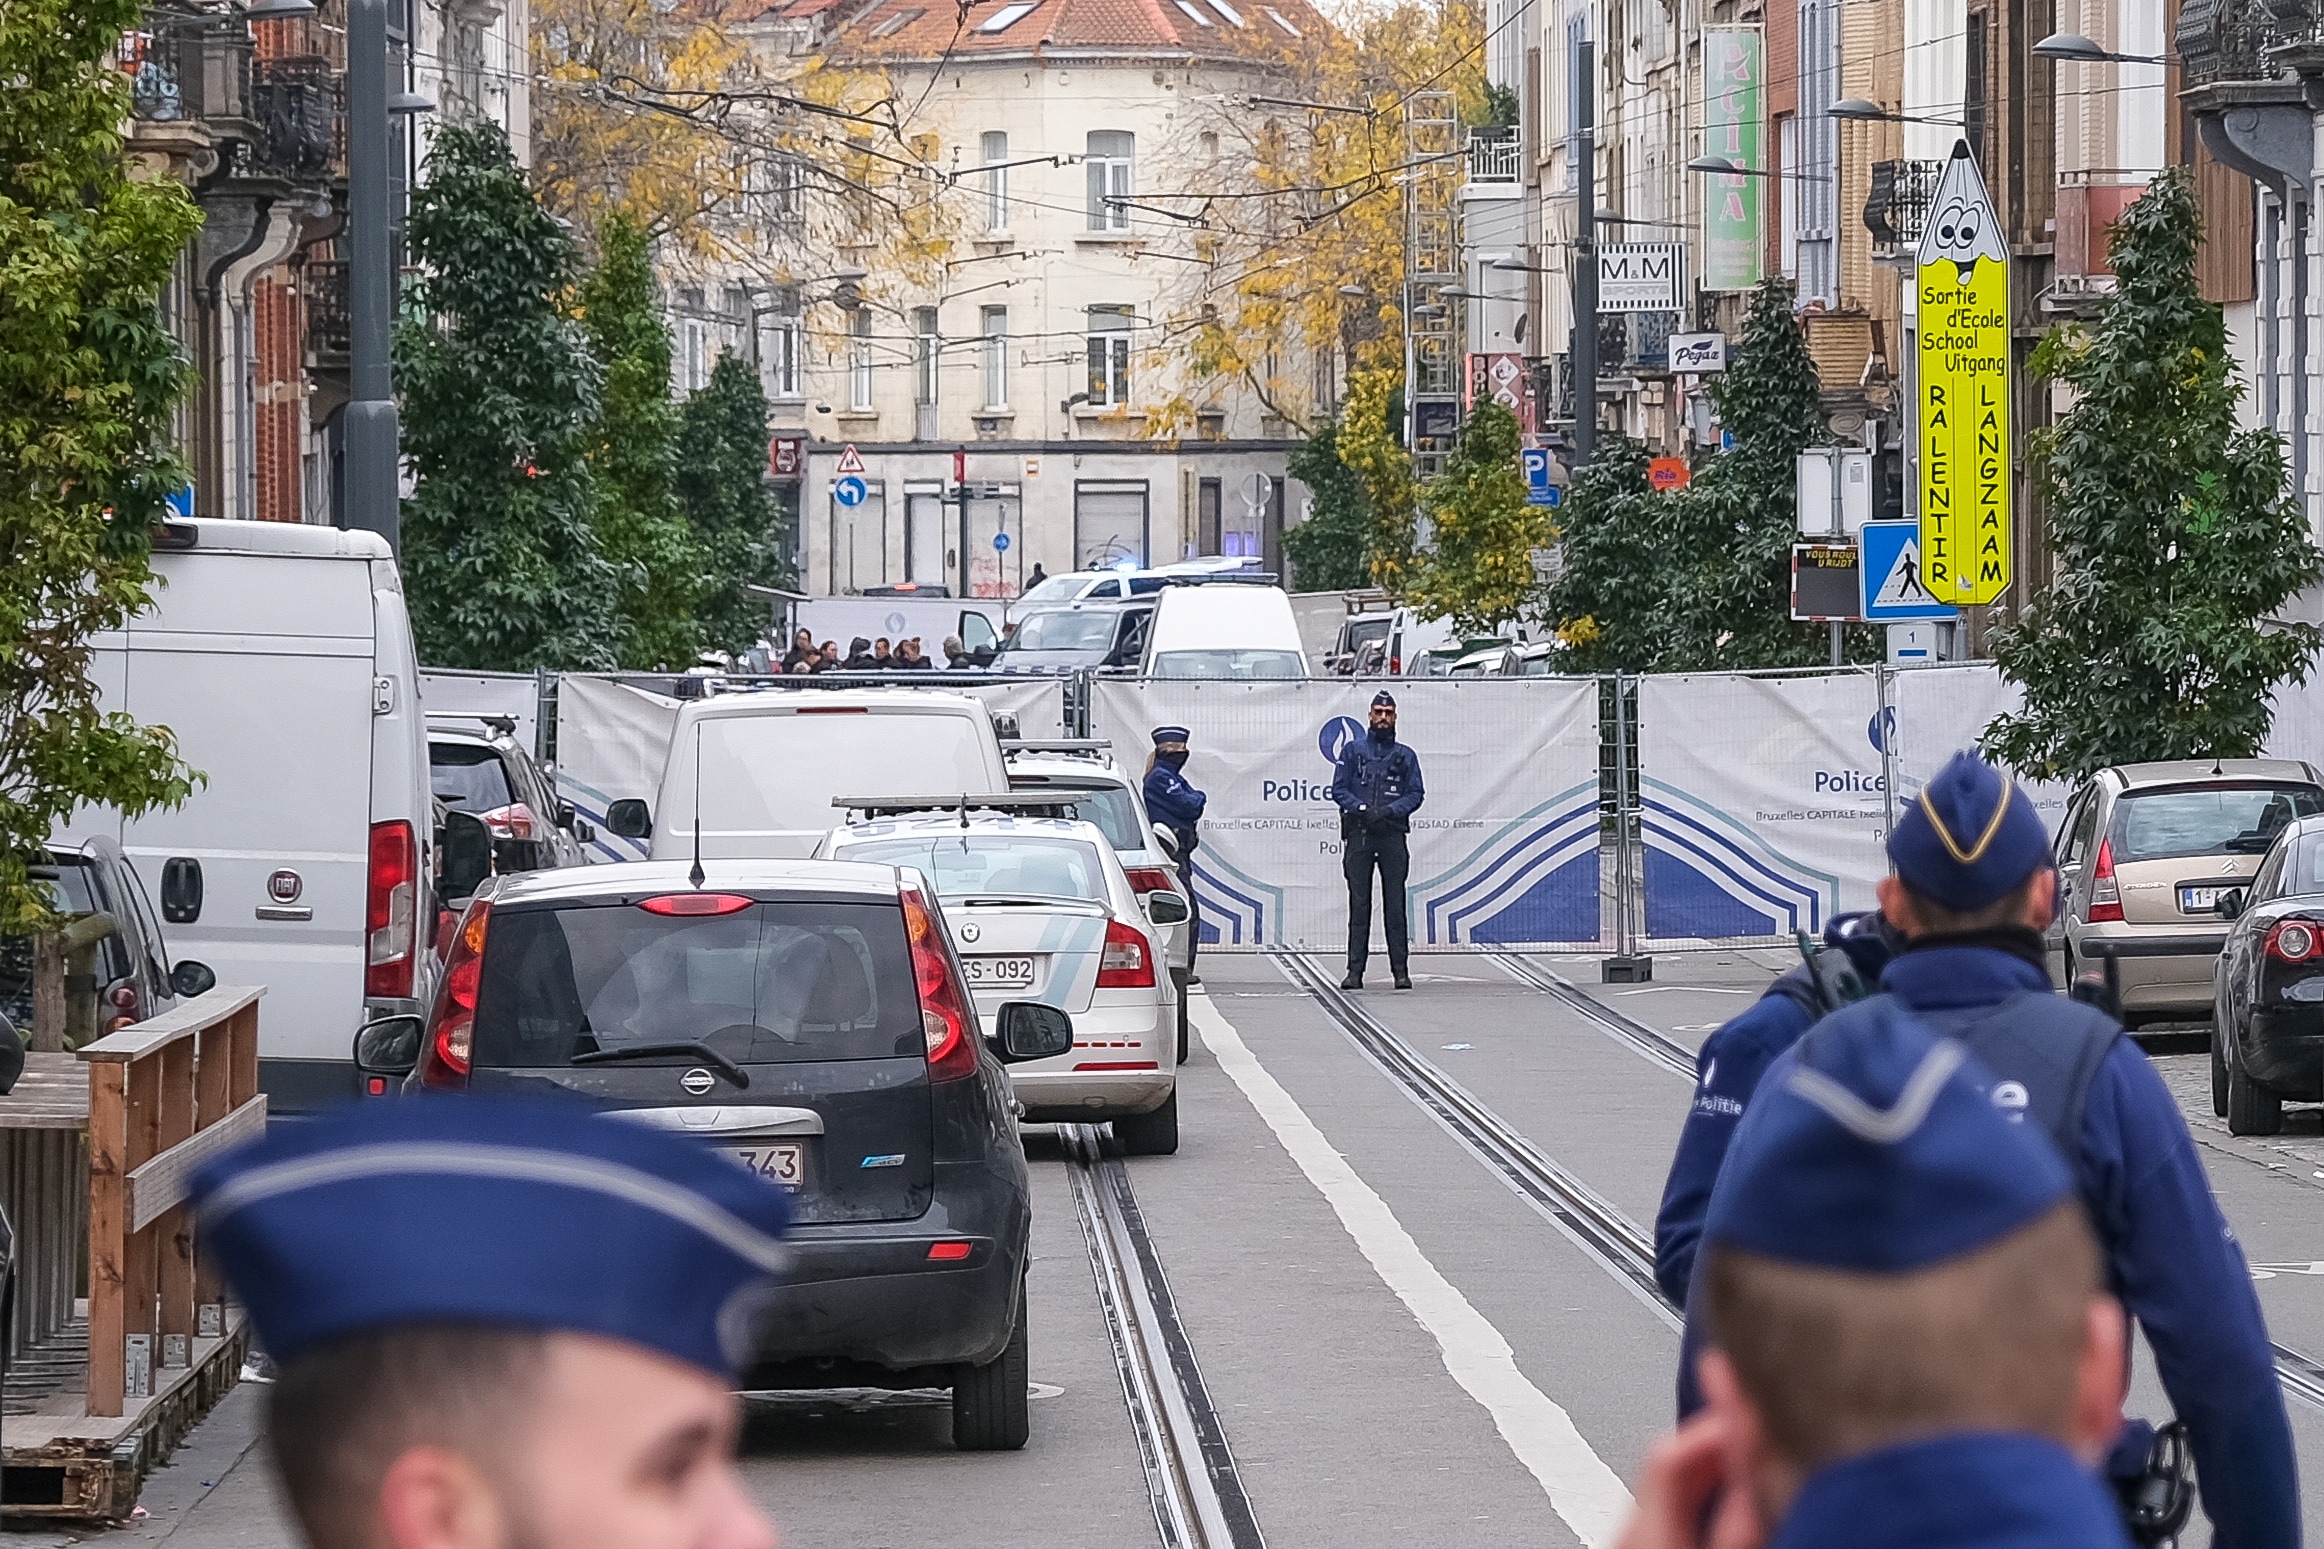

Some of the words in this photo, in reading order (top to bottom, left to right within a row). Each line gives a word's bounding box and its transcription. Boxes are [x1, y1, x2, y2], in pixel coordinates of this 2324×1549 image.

[1923, 286, 1977, 304] Sortie
[1947, 308, 2004, 328] d'Ecole
[1922, 330, 1978, 350] School
[1945, 353, 2005, 377] Uitgang
[1525, 455, 1544, 485] P
[1929, 385, 1949, 583] RALENTIR
[1979, 385, 2003, 582] LANGZAAM
[1806, 551, 1831, 559] VOUS
[1909, 631, 1915, 643] 1
[1263, 780, 1333, 801] Police
[1815, 771, 1886, 793] Police
[1203, 820, 1252, 830] Bruxelles
[1254, 820, 1302, 830] CAPITALE
[1756, 812, 1805, 821] Bruxelles
[1807, 810, 1856, 820] CAPITALE
